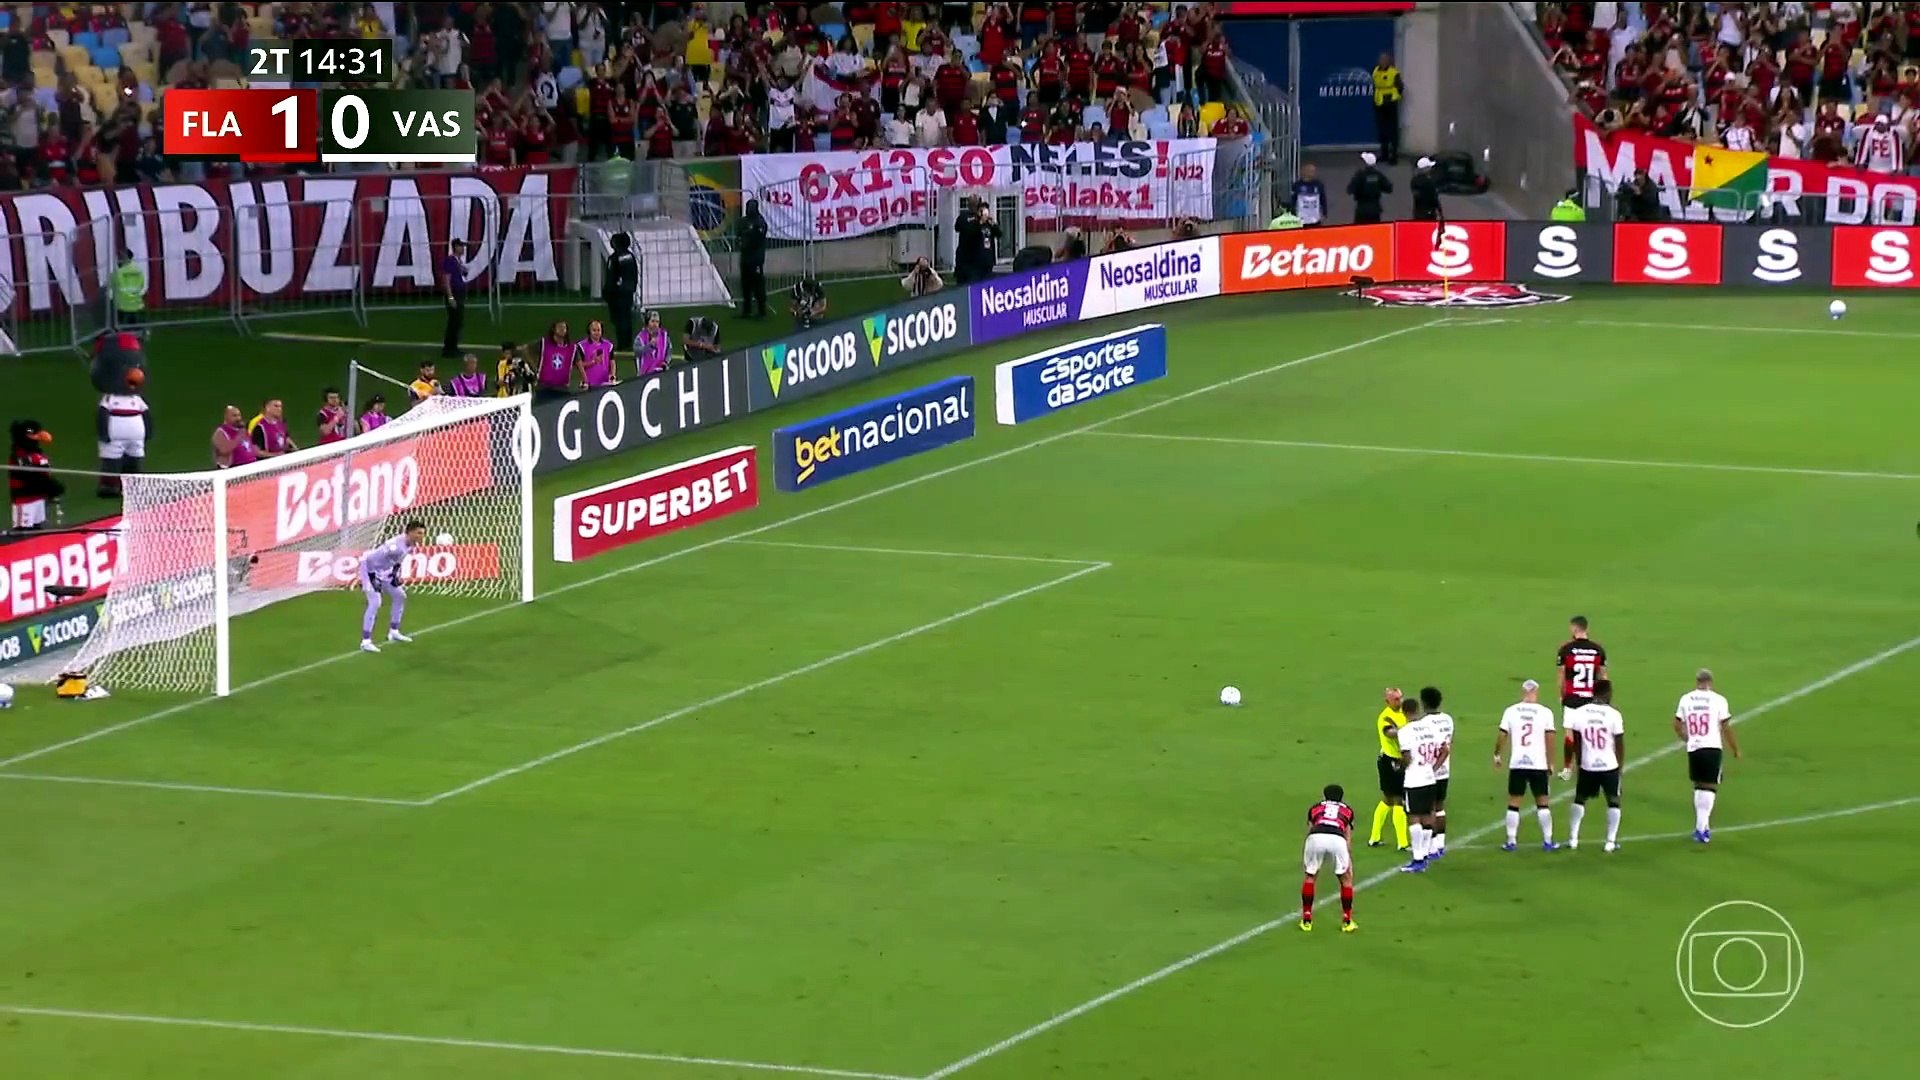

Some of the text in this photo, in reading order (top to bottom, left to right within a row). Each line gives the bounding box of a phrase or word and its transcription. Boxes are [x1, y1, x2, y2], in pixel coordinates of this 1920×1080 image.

[799, 150, 916, 203] 6x1?
[1584, 129, 1803, 220] MAR
[0, 174, 558, 312] RUBUZADA
[1241, 243, 1374, 280] Betano
[1100, 251, 1201, 290] Neosaldina
[1144, 278, 1198, 301] MUSCULAR
[981, 272, 1069, 317] Neosaldina
[886, 303, 957, 356] SICOOB
[1023, 302, 1068, 327] MUSCULAR
[786, 331, 857, 386] SICOOB
[275, 454, 418, 543] Betano
[578, 458, 749, 538] SUPERBET
[296, 551, 457, 584] Beno
[43, 615, 89, 647] SICOOB
[1572, 663, 1595, 688] 21
[1521, 723, 1533, 747] 2
[1584, 727, 1607, 749] 46
[1688, 712, 1710, 736] 88
